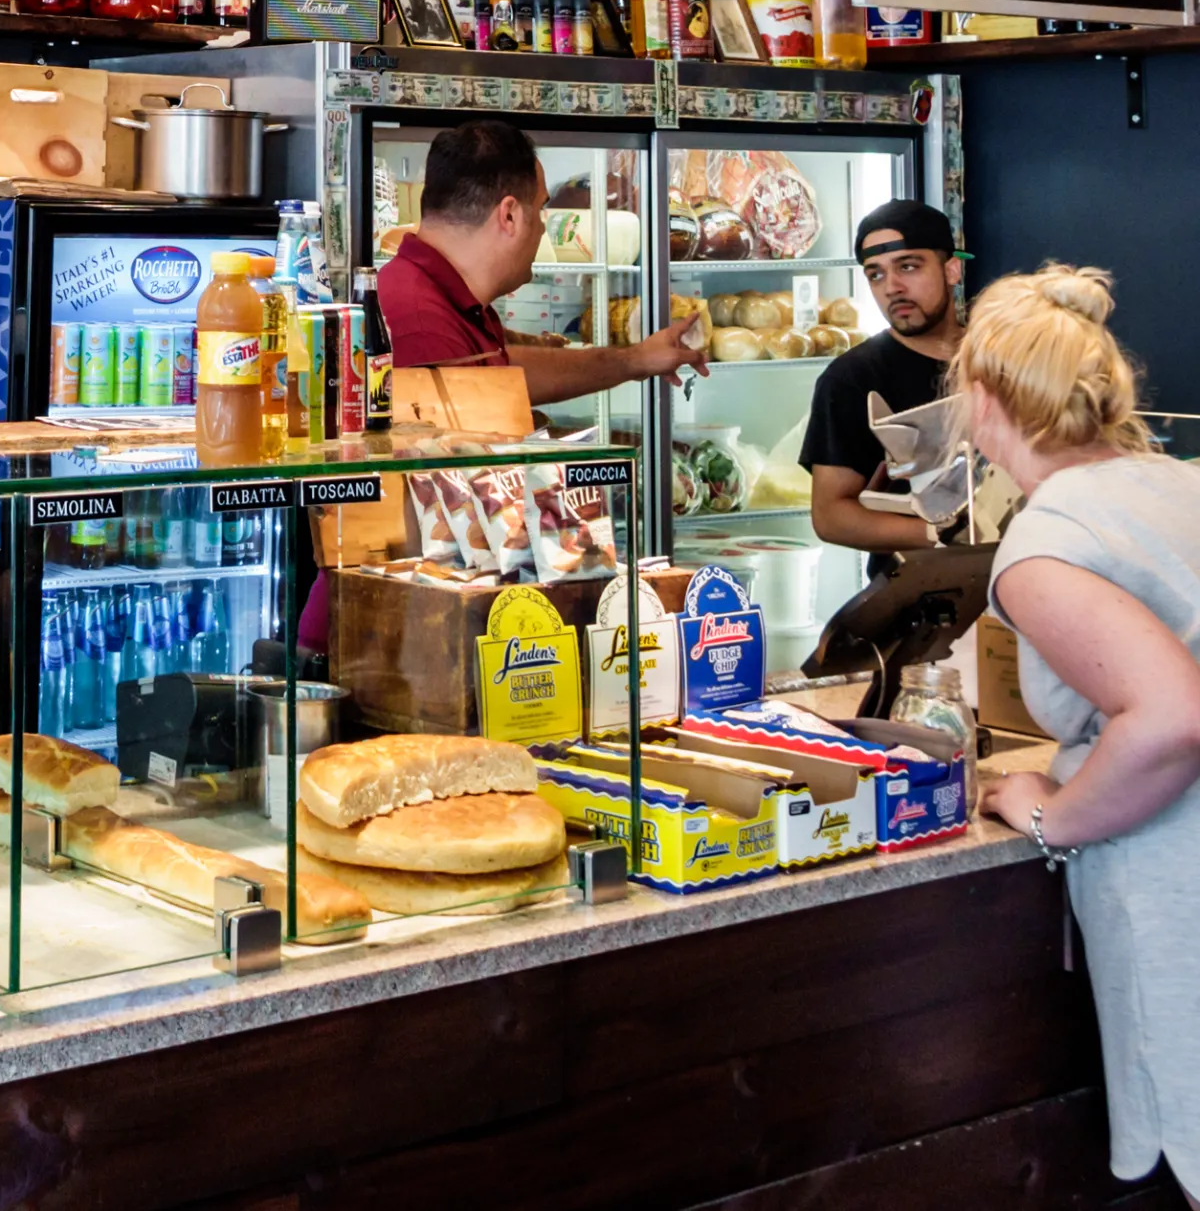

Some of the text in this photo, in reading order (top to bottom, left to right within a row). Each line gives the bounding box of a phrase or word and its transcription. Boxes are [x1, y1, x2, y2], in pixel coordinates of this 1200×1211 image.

[297, 0, 349, 15] Marshall
[54, 245, 116, 287] ITALY'S #1
[132, 259, 200, 279] ROCCHETTA
[55, 260, 125, 304] SPARKLING
[70, 282, 119, 313] WATER!
[568, 466, 628, 483] FOCACCIA
[216, 488, 287, 506] CIABATTA
[308, 482, 375, 500] TOSCANO
[556, 486, 601, 522] KETTLE
[37, 498, 117, 518] SEMOLINA
[600, 624, 664, 672] Lien's
[690, 612, 754, 661] Linden's
[493, 636, 562, 685] Linden's
[708, 645, 742, 663] FUDGE
[713, 659, 738, 675] CHIP
[510, 685, 556, 702] CRUNCH
[511, 671, 554, 689] BUTTER
[583, 807, 658, 841] BUTTR
[812, 808, 851, 839] Linden's
[888, 798, 928, 830] Linden's
[685, 836, 732, 868] Linden's
[736, 836, 777, 859] CRUNCH
